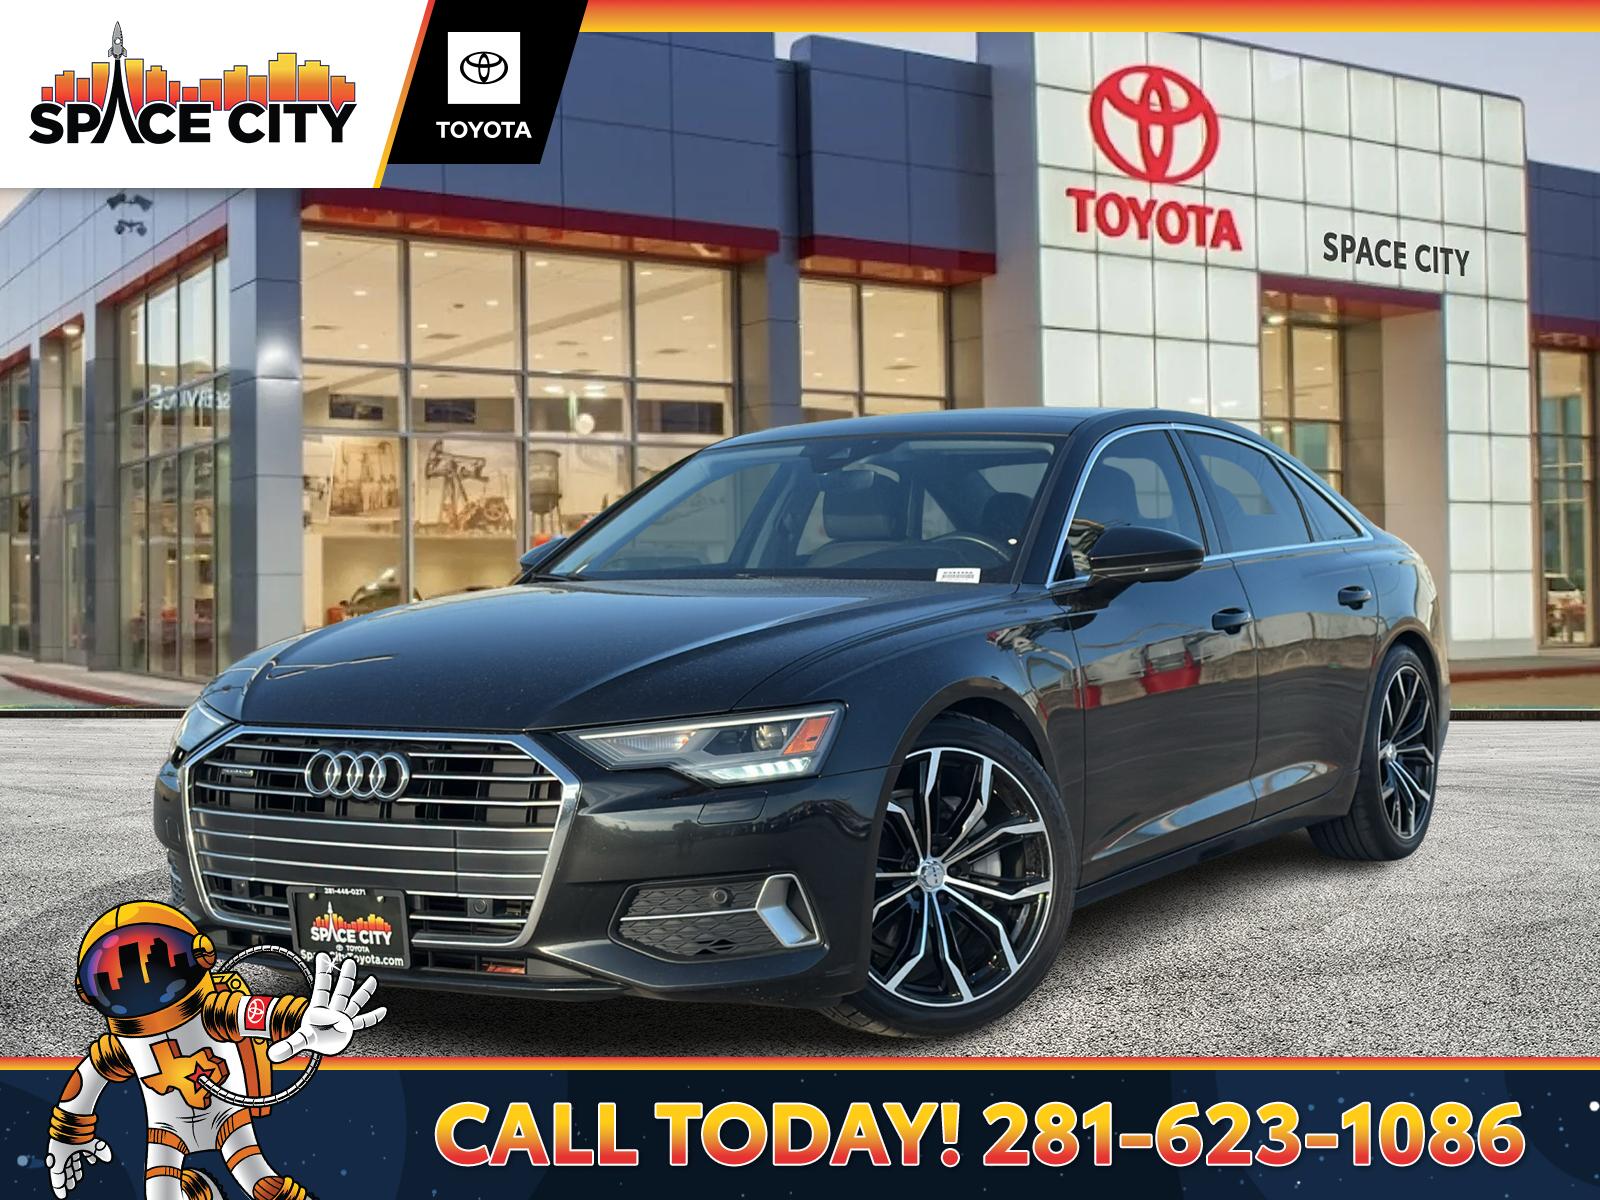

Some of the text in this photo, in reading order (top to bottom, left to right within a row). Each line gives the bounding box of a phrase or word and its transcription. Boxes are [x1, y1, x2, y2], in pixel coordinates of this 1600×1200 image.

[1066, 187, 1243, 251] TOYOTA
[1323, 231, 1470, 277] SPACE CITY
[310, 923, 393, 946] SPACE CITY
[345, 944, 371, 953] TOYOTA
